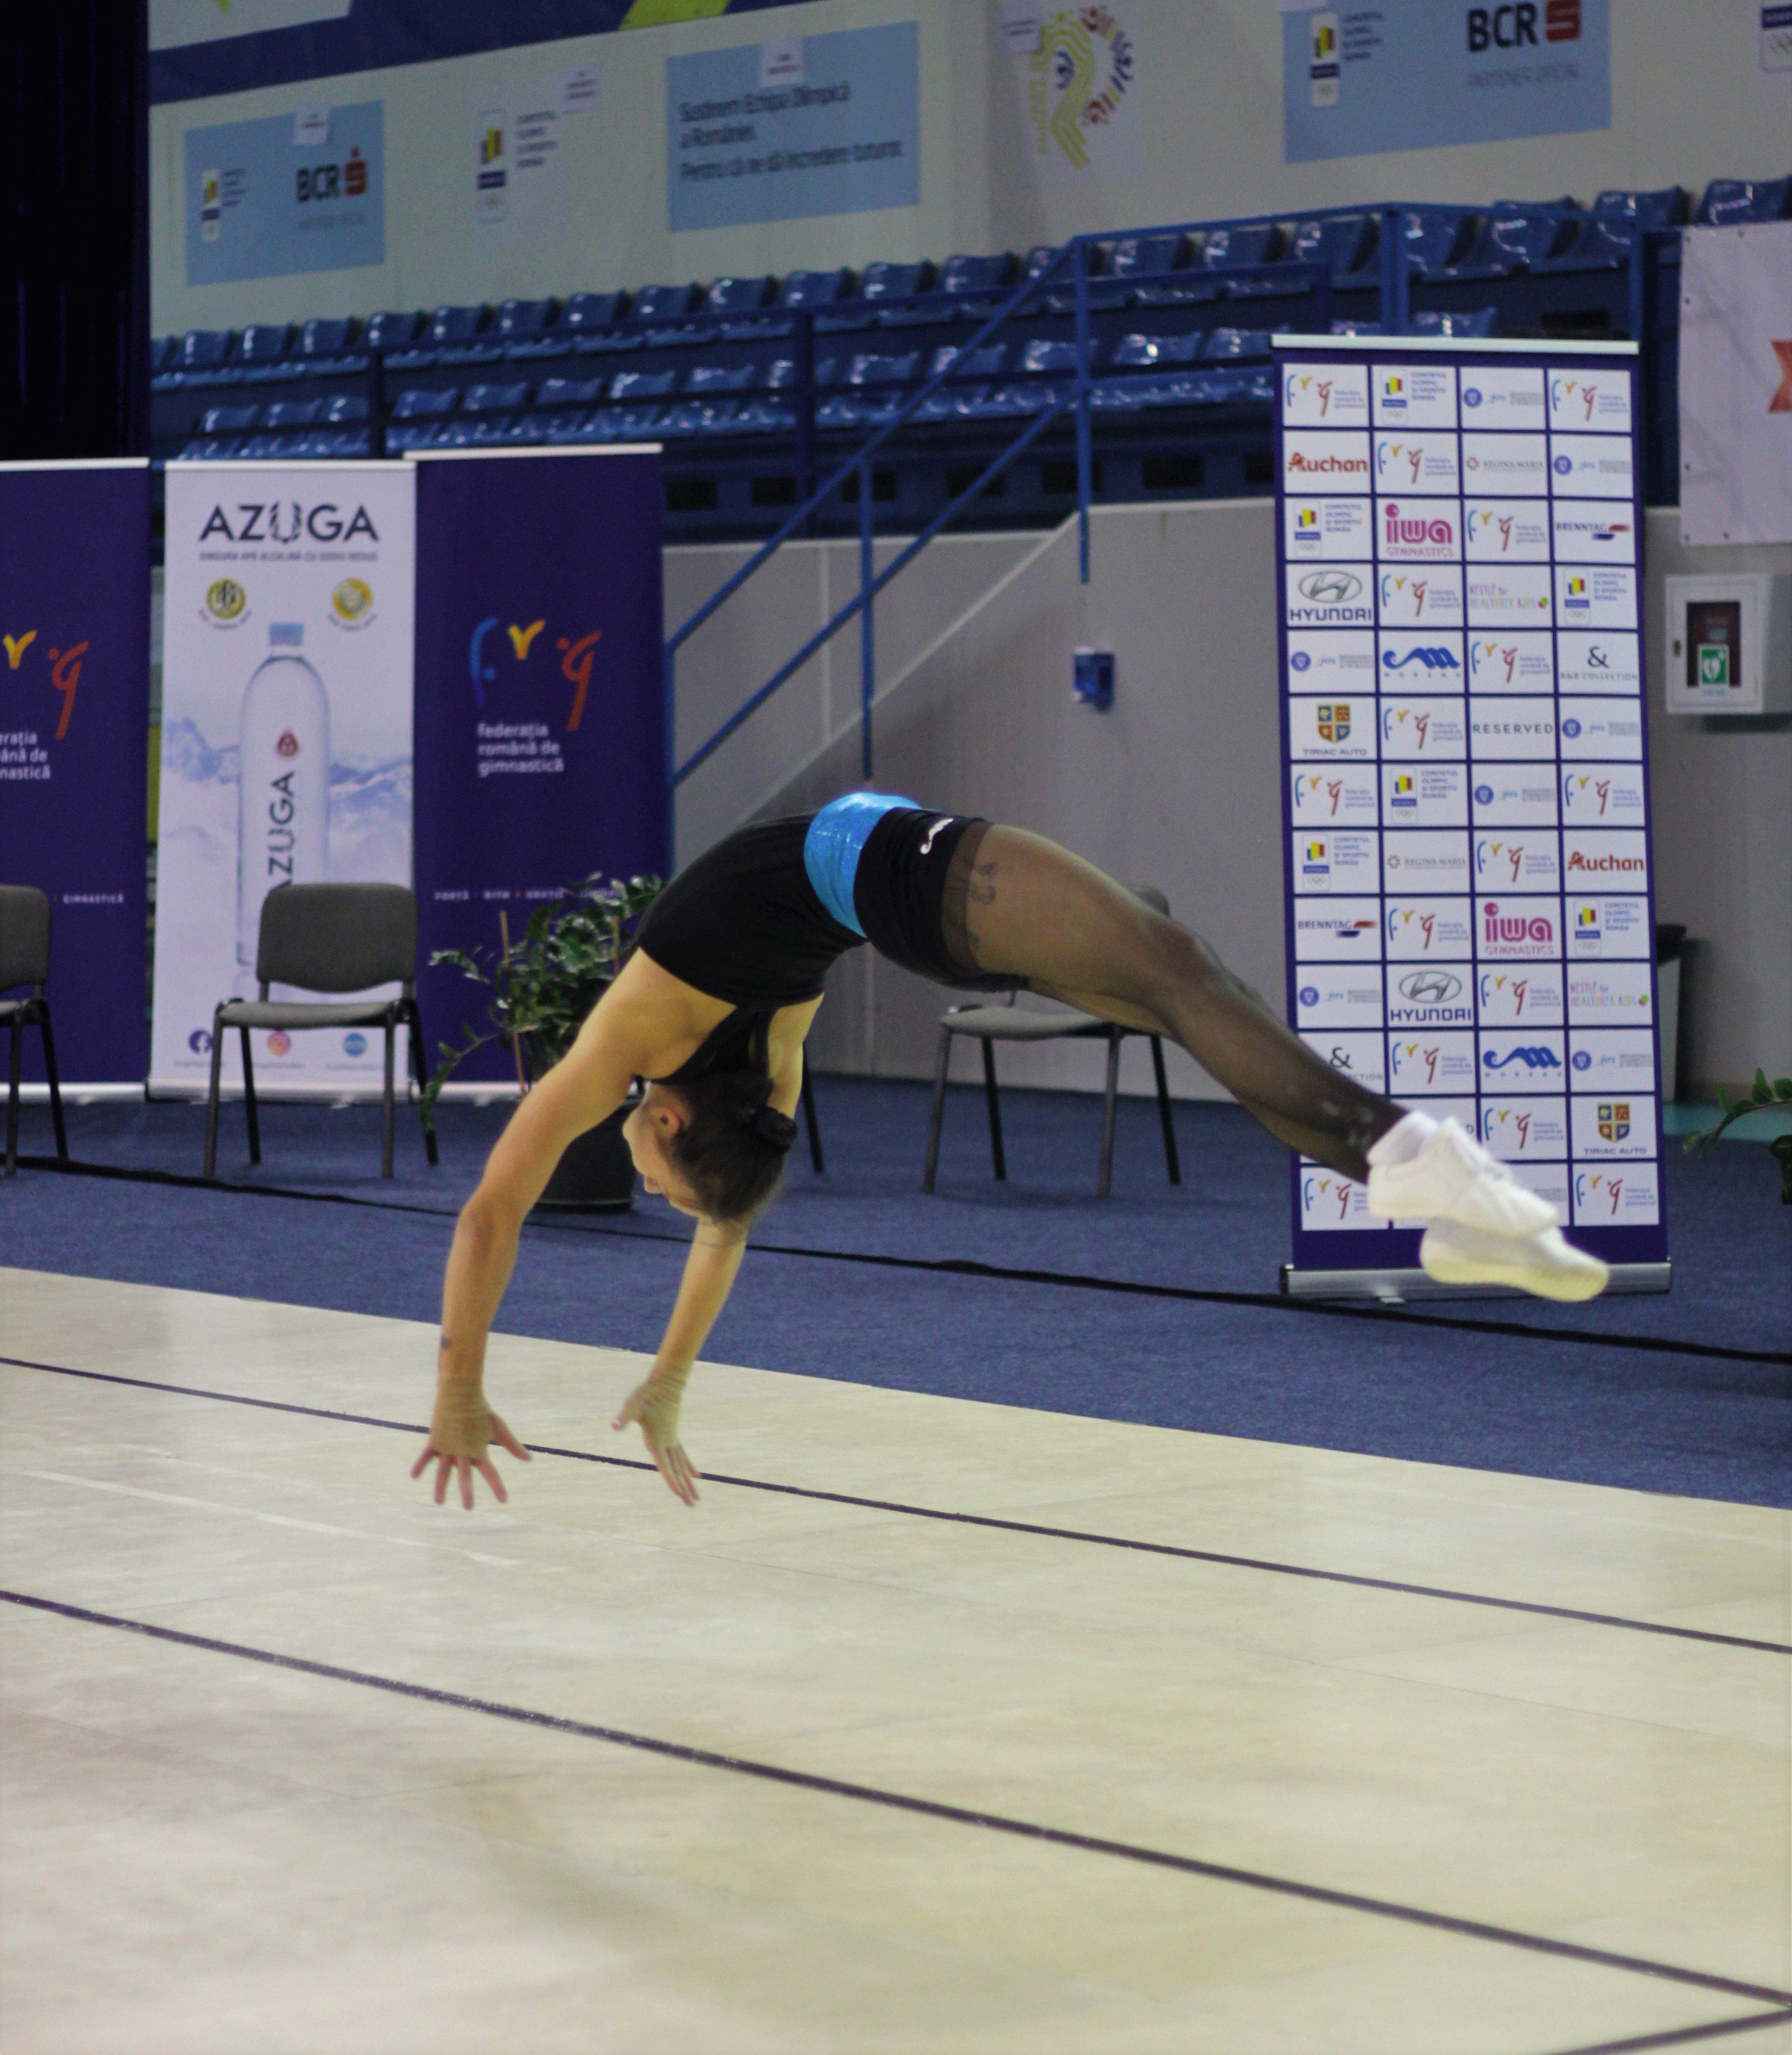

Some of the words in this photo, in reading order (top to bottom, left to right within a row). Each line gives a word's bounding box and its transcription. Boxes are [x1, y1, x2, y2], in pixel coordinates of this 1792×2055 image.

[1467, 3, 1538, 52] BCR
[296, 164, 339, 202] BCR
[1288, 452, 1368, 473] Auchan
[199, 501, 379, 544] AZUGA
[1385, 504, 1453, 544] iwa
[1556, 522, 1606, 532] BRENNTAG
[1387, 546, 1454, 558] GYMNASTICS
[1290, 607, 1372, 621] HYUNDAI
[1588, 646, 1610, 669] &
[1582, 673, 1638, 681] COLLECTION
[1473, 723, 1553, 734] RESERVED
[29, 747, 48, 763] de
[541, 740, 560, 756] de
[268, 771, 296, 887] ZUGA
[1568, 851, 1644, 871] Auchan
[1298, 921, 1351, 930] BRENNTAG
[1484, 902, 1552, 942] iwa
[1486, 944, 1554, 955] GYMNASTICS
[1390, 1008, 1472, 1021] HYUNDAI
